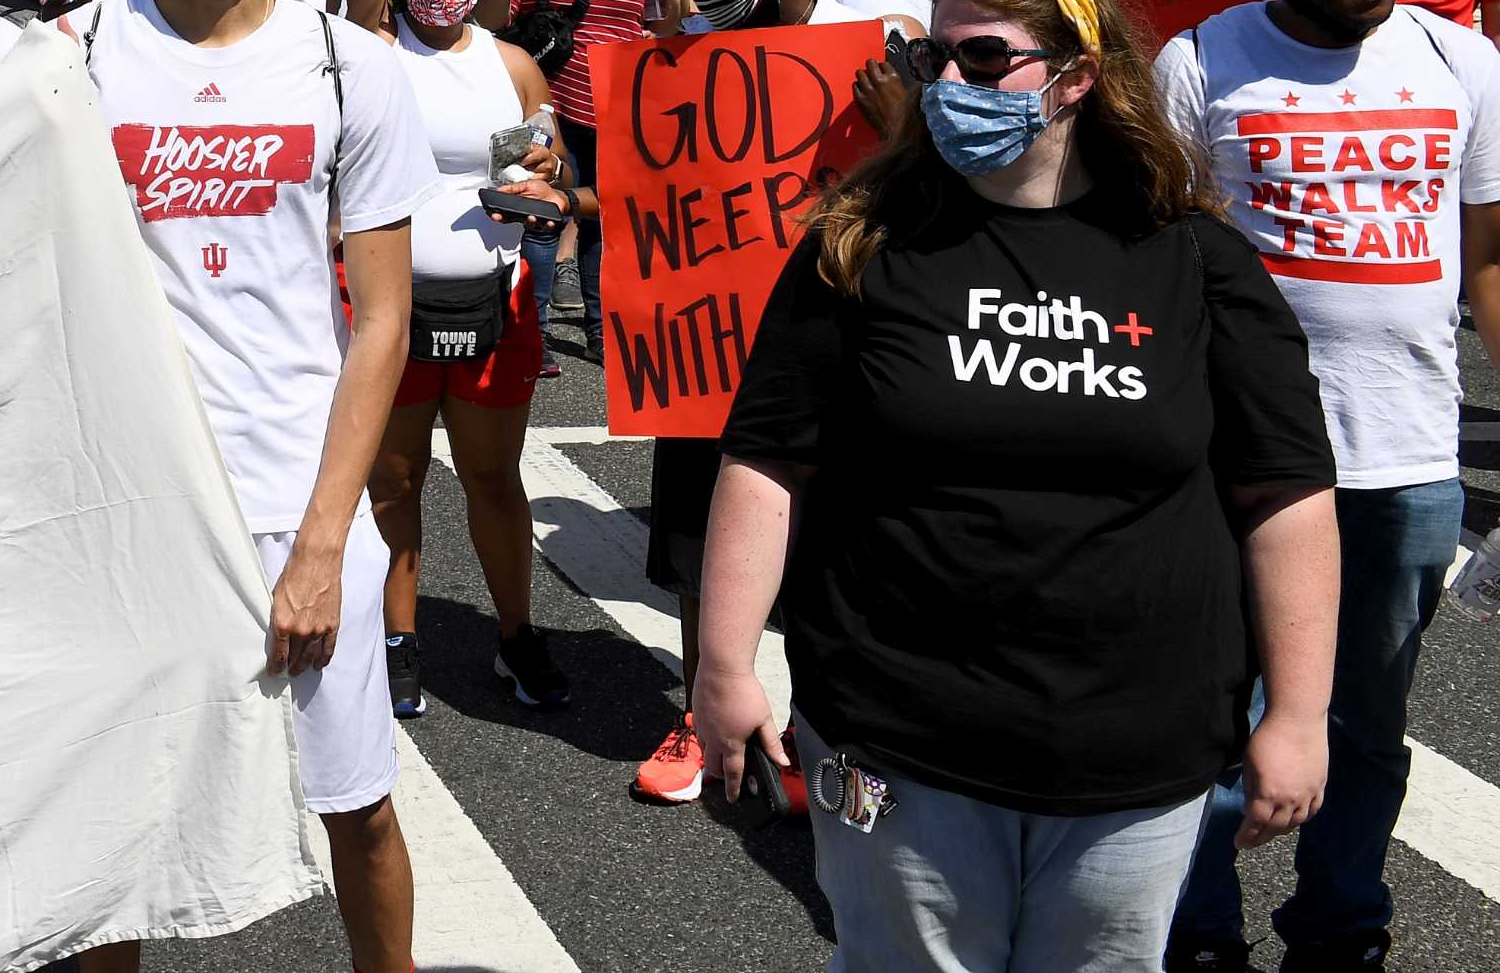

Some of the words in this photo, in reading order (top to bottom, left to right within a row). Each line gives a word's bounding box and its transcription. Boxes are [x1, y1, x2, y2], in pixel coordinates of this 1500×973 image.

[194, 94, 227, 103] adidas
[631, 45, 834, 171] GOD
[140, 128, 284, 178] HOOSIER
[1248, 134, 1451, 173] PEACE
[142, 171, 276, 212] SPIRIT
[1244, 178, 1446, 214] WALKS
[1275, 220, 1430, 259] TEAM
[432, 331, 477, 344] YOUNG
[432, 344, 476, 357] LIFE
[609, 293, 748, 413] WITH
[947, 334, 1148, 400] Works
